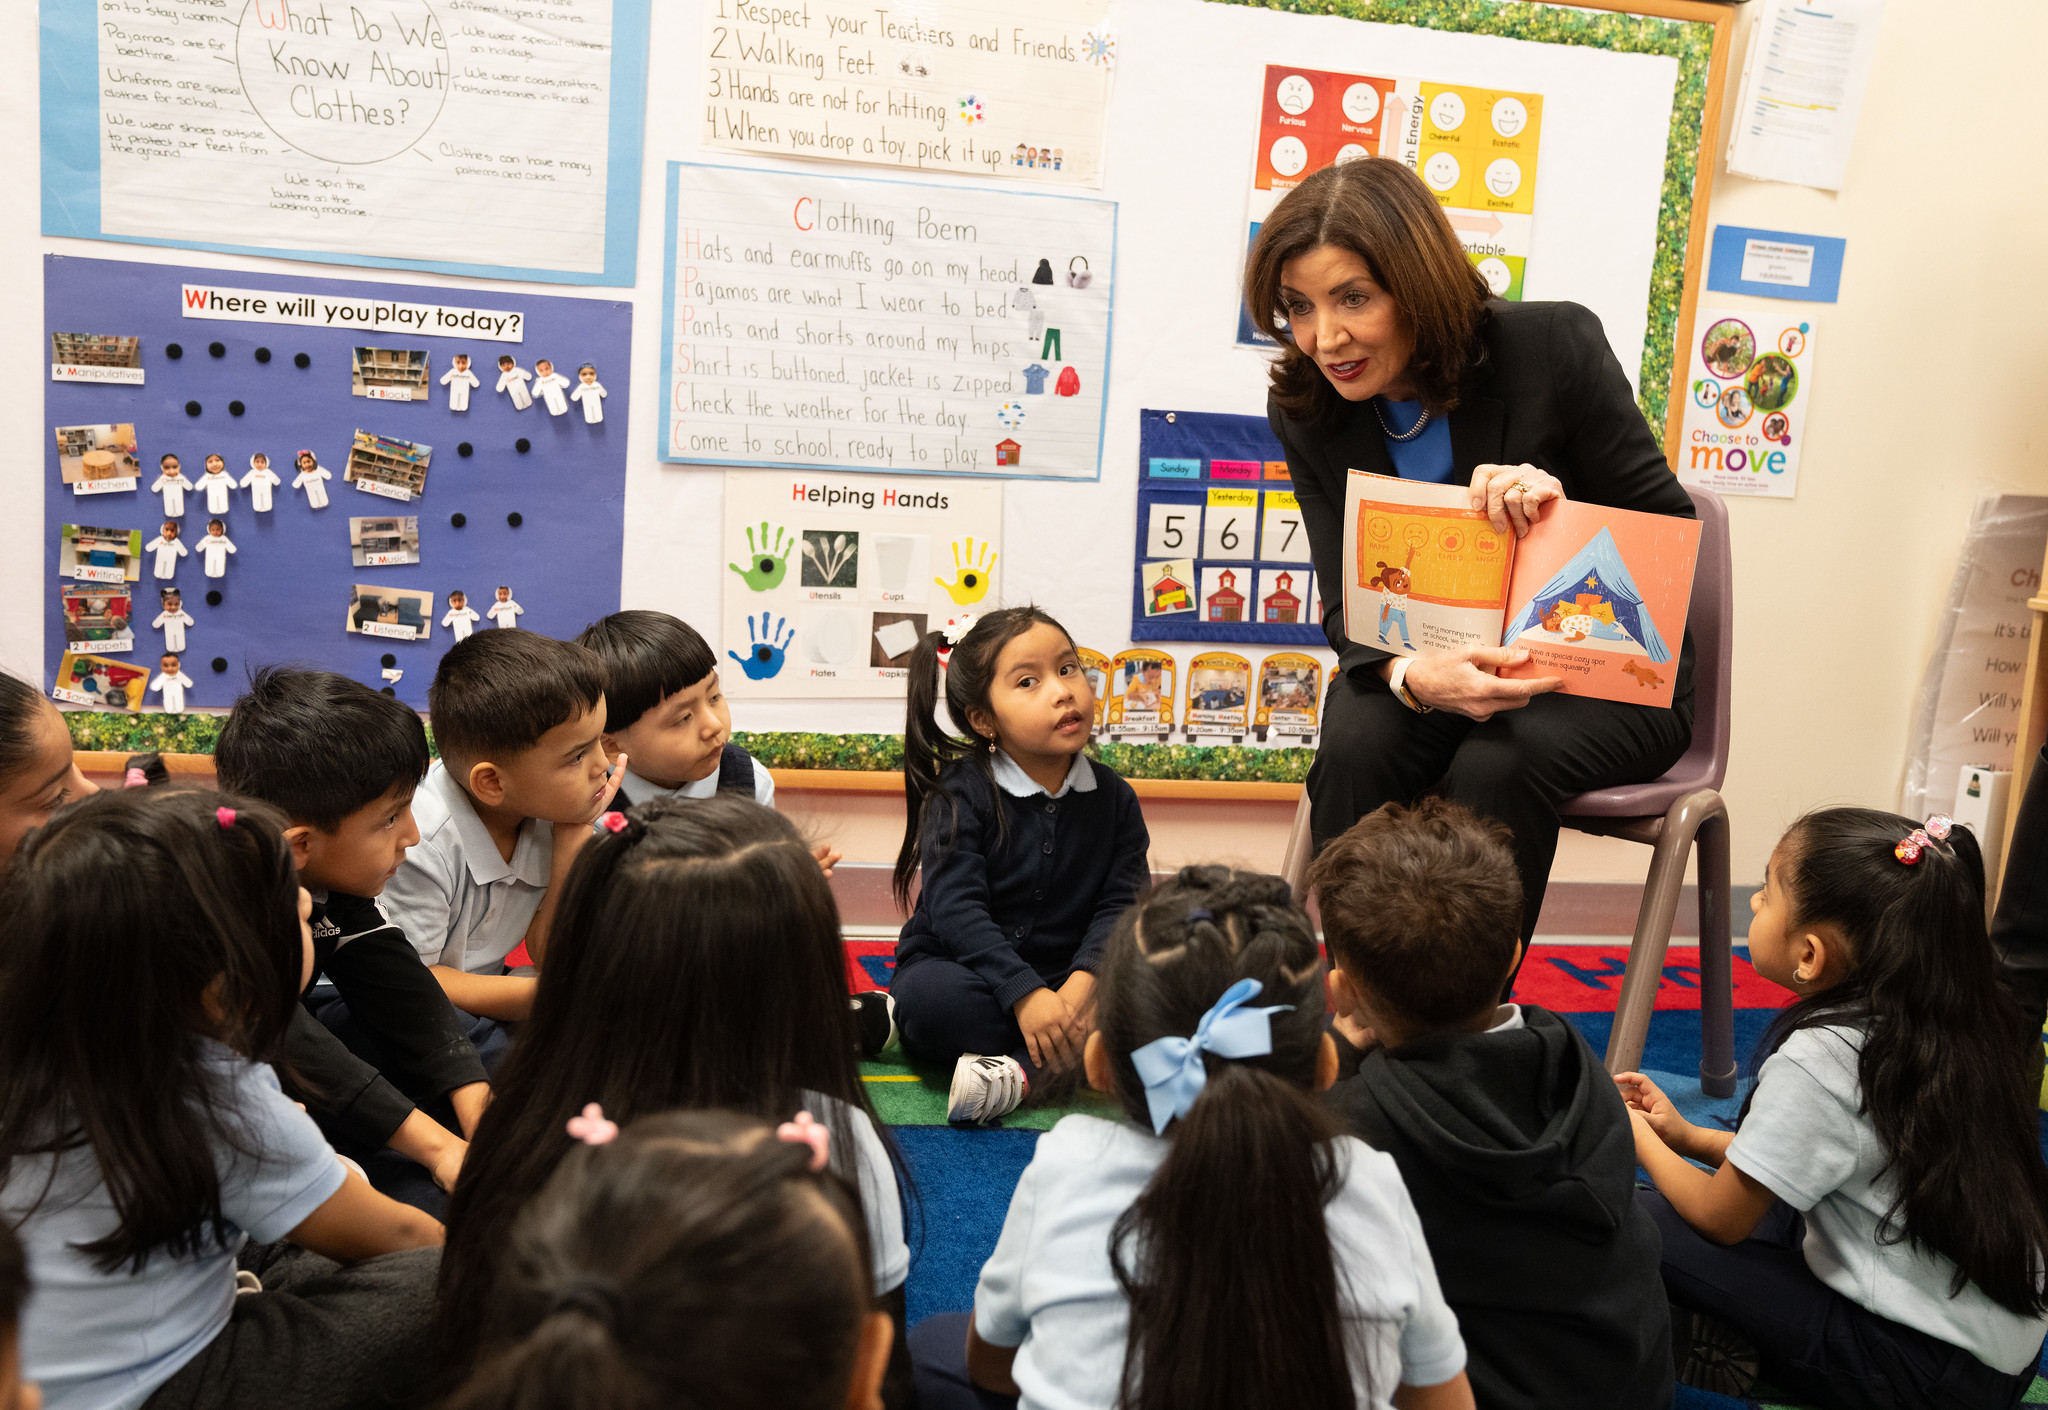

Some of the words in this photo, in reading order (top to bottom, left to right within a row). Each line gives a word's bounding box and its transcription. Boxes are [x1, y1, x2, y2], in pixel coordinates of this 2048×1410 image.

[256, 0, 332, 36] What
[351, 6, 382, 42] Do
[391, 11, 446, 50] We
[737, 0, 811, 34] Respect
[826, 14, 867, 38] your
[874, 10, 954, 47] Teachers
[970, 28, 998, 52] and
[104, 22, 174, 46] Pajamas
[736, 29, 824, 80] Walking
[268, 40, 349, 80] Know
[370, 51, 448, 90] About
[107, 68, 172, 88] Uniforms
[177, 80, 202, 91] are
[728, 68, 779, 104] Hands
[789, 92, 815, 107] are
[823, 86, 848, 110] not
[856, 90, 880, 114] for
[290, 84, 410, 125] Clothes?
[106, 112, 136, 126] We
[140, 122, 174, 130] wear
[180, 122, 216, 135] shoes
[1279, 116, 1306, 126] Furious
[1406, 96, 1424, 144] Energy
[1342, 124, 1373, 134] Nervous
[725, 108, 779, 143] When
[789, 128, 814, 148] you
[820, 120, 854, 155] drop
[863, 138, 873, 153] a
[919, 136, 951, 168] pick
[963, 138, 974, 162] it
[1429, 133, 1460, 142] Cheerful
[1492, 139, 1520, 148] Ecstatic
[439, 142, 493, 162] Clothes
[284, 173, 310, 186] We
[346, 178, 366, 191] the
[1488, 200, 1514, 208] Excited
[794, 196, 895, 246] Clothing
[918, 206, 977, 242] Poem
[686, 228, 733, 263] Hats
[744, 242, 773, 264] and
[790, 249, 872, 272] earmuffs
[884, 258, 902, 281] go
[912, 262, 933, 277] on
[947, 263, 968, 284] my
[685, 266, 758, 305] Pajamas
[768, 286, 792, 304] are
[802, 288, 842, 307] what
[856, 282, 868, 310] I
[881, 296, 925, 312] wear
[941, 291, 960, 316] to
[185, 289, 267, 314] Where
[276, 298, 315, 318] will
[324, 304, 370, 324] you
[375, 304, 428, 328] play
[437, 308, 520, 336] today?
[682, 304, 733, 340] Pants
[747, 318, 779, 340] and
[796, 320, 854, 346] shorts
[866, 326, 926, 350] around
[937, 336, 958, 360] my
[56, 366, 62, 376] 6
[68, 368, 144, 381] Manipulatives
[679, 344, 732, 376] Shirt
[744, 359, 759, 379] is
[859, 364, 914, 392] jacket
[927, 371, 940, 390] is
[380, 390, 410, 400] Blocks
[675, 381, 734, 415] Check
[745, 390, 773, 418] the
[784, 395, 853, 420] weather
[864, 396, 888, 422] for
[898, 397, 927, 426] the
[674, 420, 728, 452] Come
[743, 424, 762, 453] to
[848, 436, 893, 466] ready
[910, 433, 927, 462] to
[1692, 430, 1742, 444] Choose
[1746, 434, 1758, 446] to
[1690, 446, 1786, 474] move
[1160, 464, 1190, 476] Sunday
[1220, 466, 1252, 476] Monday
[76, 482, 82, 490] 4
[88, 480, 128, 490] Kitchen
[371, 484, 410, 498] Science
[793, 484, 875, 509] Helping
[884, 489, 949, 509] Hands
[1212, 491, 1254, 504] Yesterday
[1276, 493, 1299, 508] Toda
[1163, 516, 1186, 548] 5
[1221, 518, 1239, 550] 6
[1281, 520, 1298, 552] 7
[368, 556, 374, 565] 2
[378, 554, 406, 564] Music
[76, 568, 82, 577] 2
[88, 569, 123, 583] Writing
[810, 592, 842, 600] Utensils
[882, 592, 905, 602] Cups
[364, 624, 370, 632] 2
[374, 625, 416, 640] Listening
[1423, 622, 1439, 634] Every
[1440, 628, 1464, 639] morning
[73, 643, 80, 651] 2
[84, 640, 128, 652] Puppets
[1574, 656, 1590, 666] cozy
[1986, 658, 2020, 674] How
[810, 669, 836, 678] Plates
[55, 689, 62, 698] 2
[66, 692, 94, 705] Sand
[1218, 714, 1242, 722] Meeting
[1974, 728, 2000, 744] Will
[314, 928, 340, 938] didas
